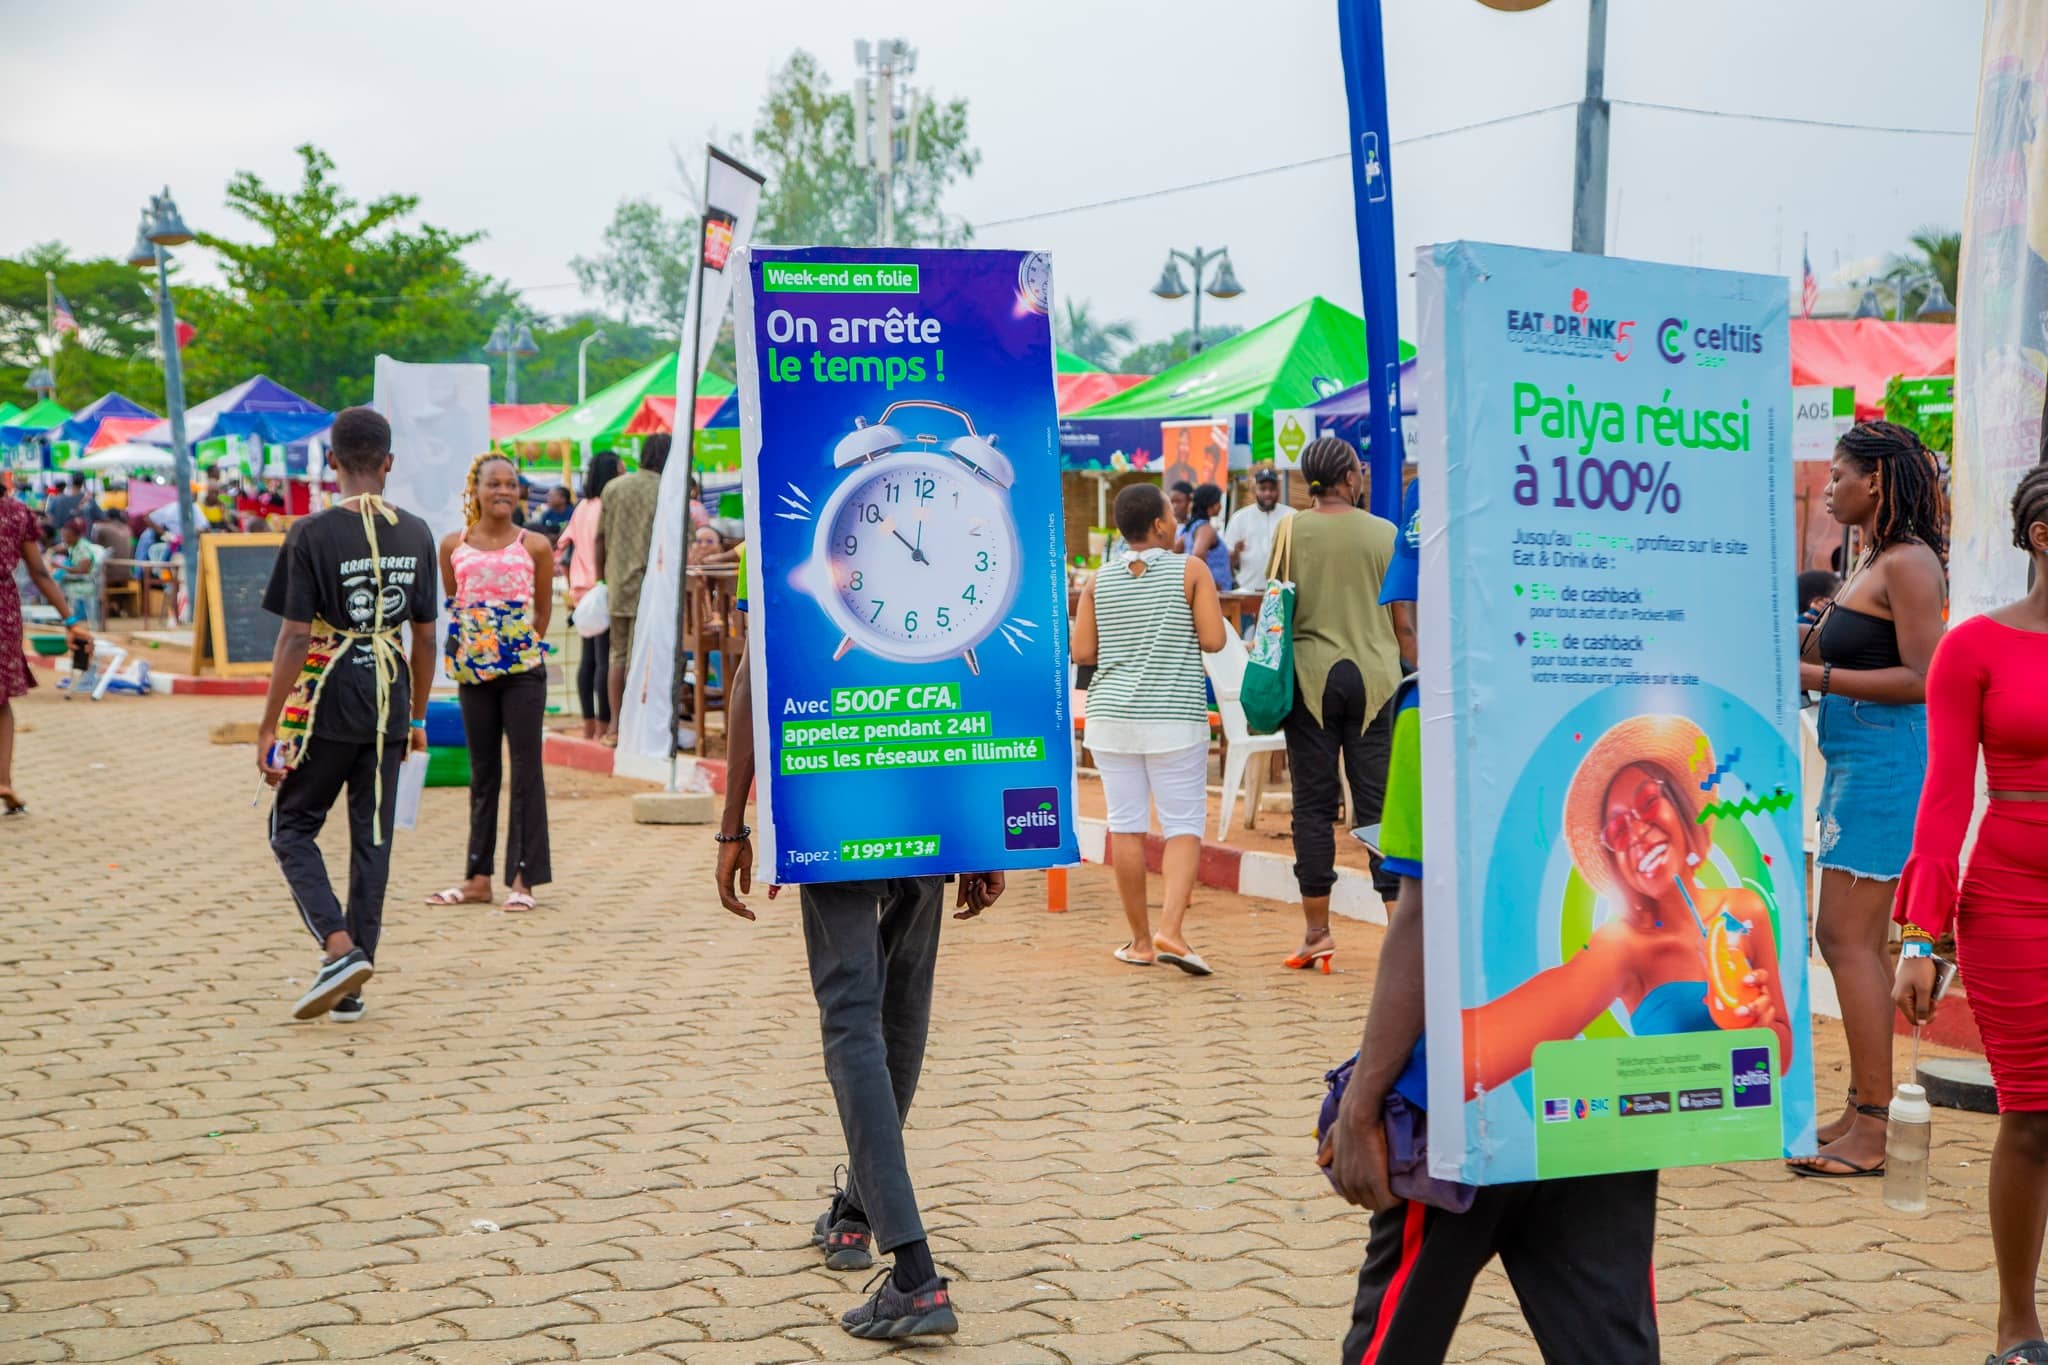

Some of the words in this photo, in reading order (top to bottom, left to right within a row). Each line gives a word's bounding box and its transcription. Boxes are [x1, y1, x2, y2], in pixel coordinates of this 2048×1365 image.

[767, 269, 849, 287] Week-end
[853, 273, 873, 287] en
[876, 270, 913, 287] folie
[766, 309, 818, 343] On
[828, 307, 942, 344] arrête
[1507, 309, 1544, 332] EAT
[1554, 314, 1617, 340] DRINK
[1614, 321, 1637, 363] 5
[1694, 322, 1763, 354] celtiis
[768, 347, 802, 382] le
[809, 350, 927, 391] temps
[935, 349, 945, 382] !
[1513, 382, 1625, 456] Paiya
[1636, 388, 1750, 452] réussi
[1797, 401, 1830, 420] A05
[914, 478, 935, 499] 12
[1513, 445, 1539, 506] à
[1552, 456, 1681, 515] 100%
[884, 483, 900, 503] 11
[857, 503, 880, 523] 10
[844, 535, 858, 556] 9
[1048, 513, 1057, 558] dimanches
[1512, 529, 1573, 549] Jusqu'au
[1636, 535, 1685, 553] profitez
[1688, 540, 1709, 553] sur
[1711, 538, 1722, 553] le
[1725, 539, 1749, 555] site
[974, 551, 988, 572] 3
[1051, 558, 1057, 567] et
[1513, 549, 1536, 567] Eat
[1539, 550, 1550, 567] &
[1553, 551, 1590, 568] Drink
[1592, 553, 1608, 569] de
[849, 571, 863, 591] 8
[1050, 569, 1058, 603] samedis
[962, 584, 977, 605] 4
[1561, 585, 1578, 601] de
[1581, 586, 1643, 603] cashback
[871, 600, 884, 622] 7
[904, 611, 918, 632] 6
[936, 607, 950, 627] 5
[1530, 607, 1553, 620] pour
[1556, 607, 1576, 619] tout
[1580, 607, 1608, 619] achat
[1052, 617, 1062, 668] uniquement
[1563, 633, 1579, 650] de
[1583, 634, 1644, 651] cashback
[1531, 656, 1554, 668] pour
[1557, 656, 1577, 667] tout
[1580, 656, 1608, 667] achat
[1610, 656, 1633, 667] chez
[1054, 670, 1063, 698] valable
[1532, 672, 1557, 683] votre
[1561, 673, 1612, 684] restaurant
[1670, 673, 1679, 685] le
[1681, 673, 1699, 686] site
[783, 698, 829, 715] Avec
[835, 687, 901, 713] 500F
[906, 686, 957, 710] CFA,
[1055, 701, 1063, 721] offre
[784, 723, 860, 746] appelez
[864, 719, 942, 743] pendant
[947, 716, 986, 735] 24H
[786, 753, 829, 771] tous
[833, 750, 861, 767] les
[866, 747, 940, 766] réseaux
[944, 748, 967, 762] en
[972, 739, 1037, 760] illimité
[1006, 811, 1057, 828] celtiis
[788, 850, 829, 865] Tapez
